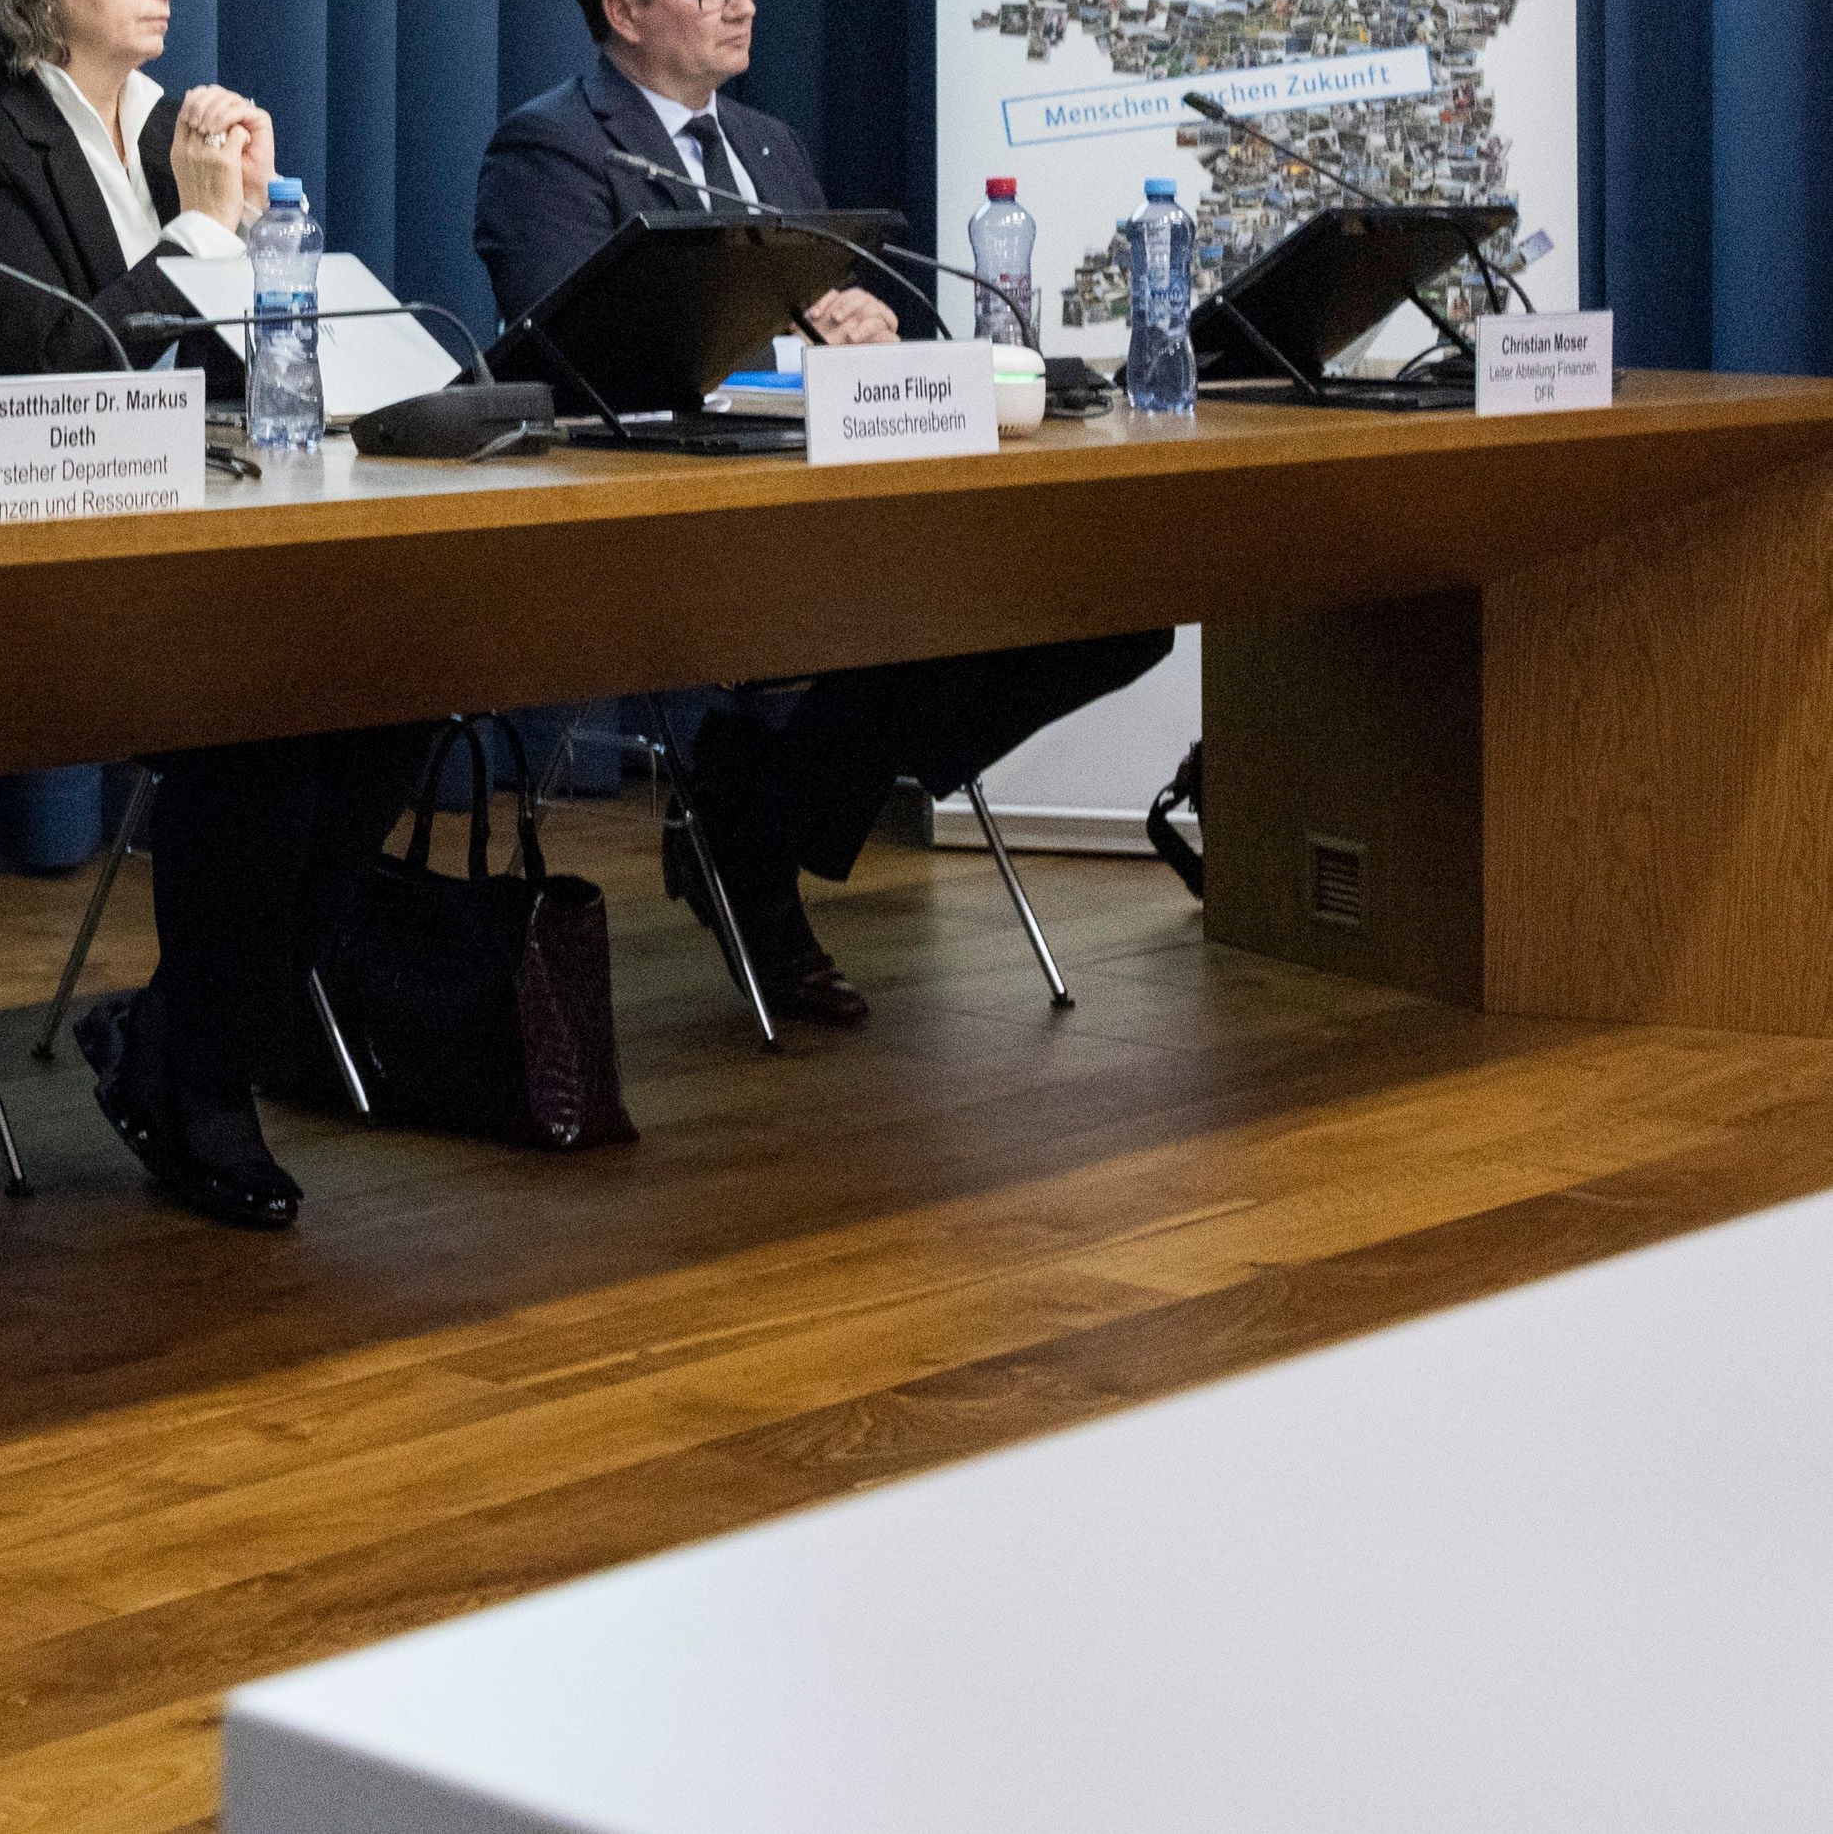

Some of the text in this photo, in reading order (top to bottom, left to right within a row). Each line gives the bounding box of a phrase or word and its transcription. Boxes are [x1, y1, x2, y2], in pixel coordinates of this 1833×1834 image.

[1044, 63, 1391, 129] Menschen chen Zukunft
[1501, 333, 1589, 355] Christian Moser
[1489, 364, 1513, 382] Leiter
[1515, 361, 1556, 381] Abteilung
[95, 391, 120, 413] Dr.
[126, 388, 188, 411] Markus
[853, 375, 952, 403] Joana Filippi
[50, 425, 96, 448] Dieth
[842, 410, 967, 439] Staatsschreiberin
[62, 454, 168, 484] Departement
[45, 492, 77, 516] und
[82, 488, 180, 513] Ressourcen
